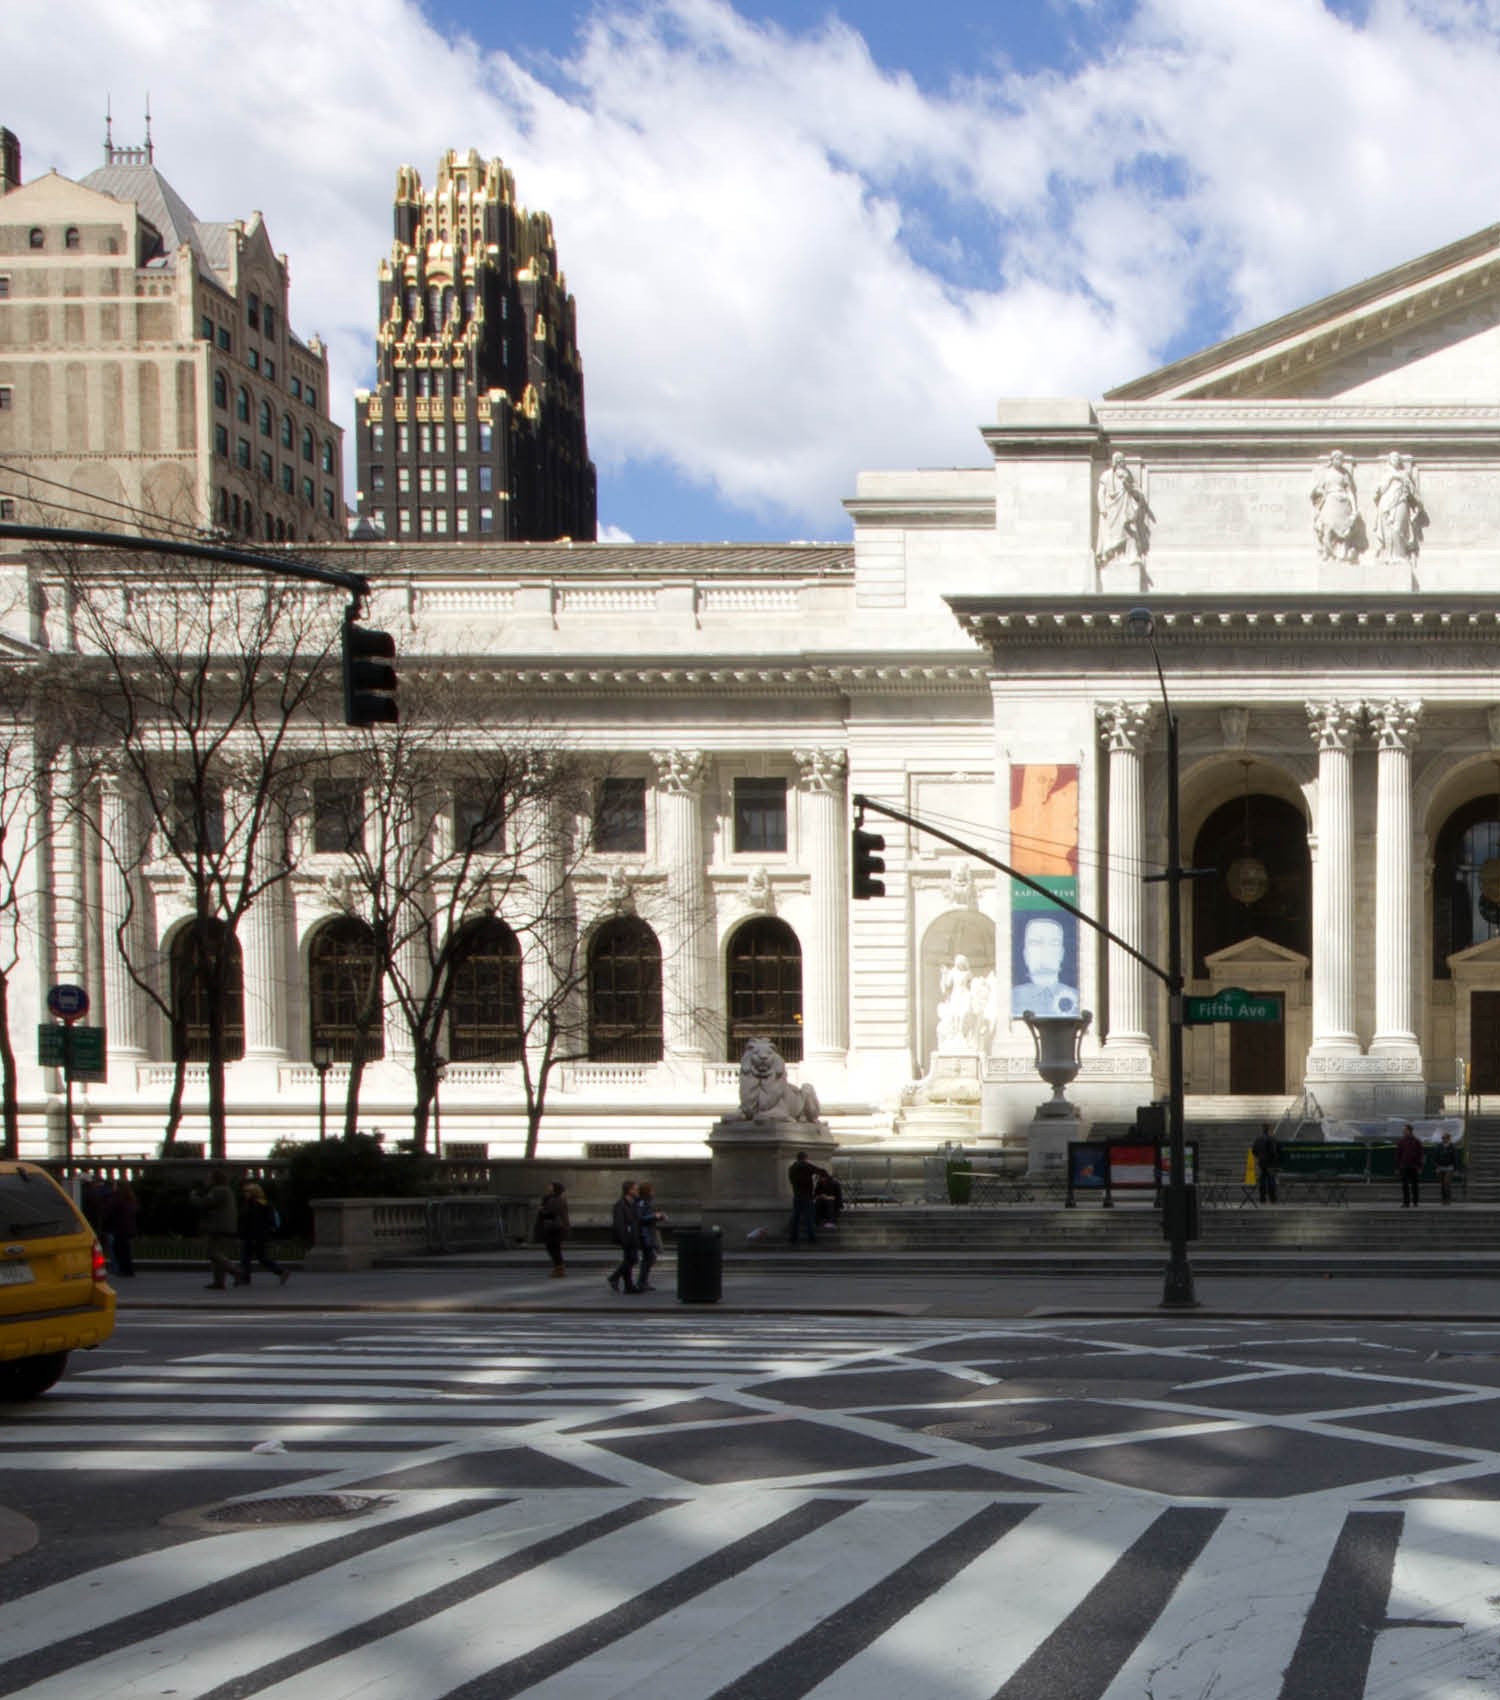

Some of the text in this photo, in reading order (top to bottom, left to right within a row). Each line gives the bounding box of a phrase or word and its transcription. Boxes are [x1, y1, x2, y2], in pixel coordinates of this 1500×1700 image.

[1263, 648, 1311, 667] THE
[1336, 648, 1394, 667] NEW
[1421, 646, 1497, 667] YORK
[1199, 1002, 1266, 1017] Fifth Ave
